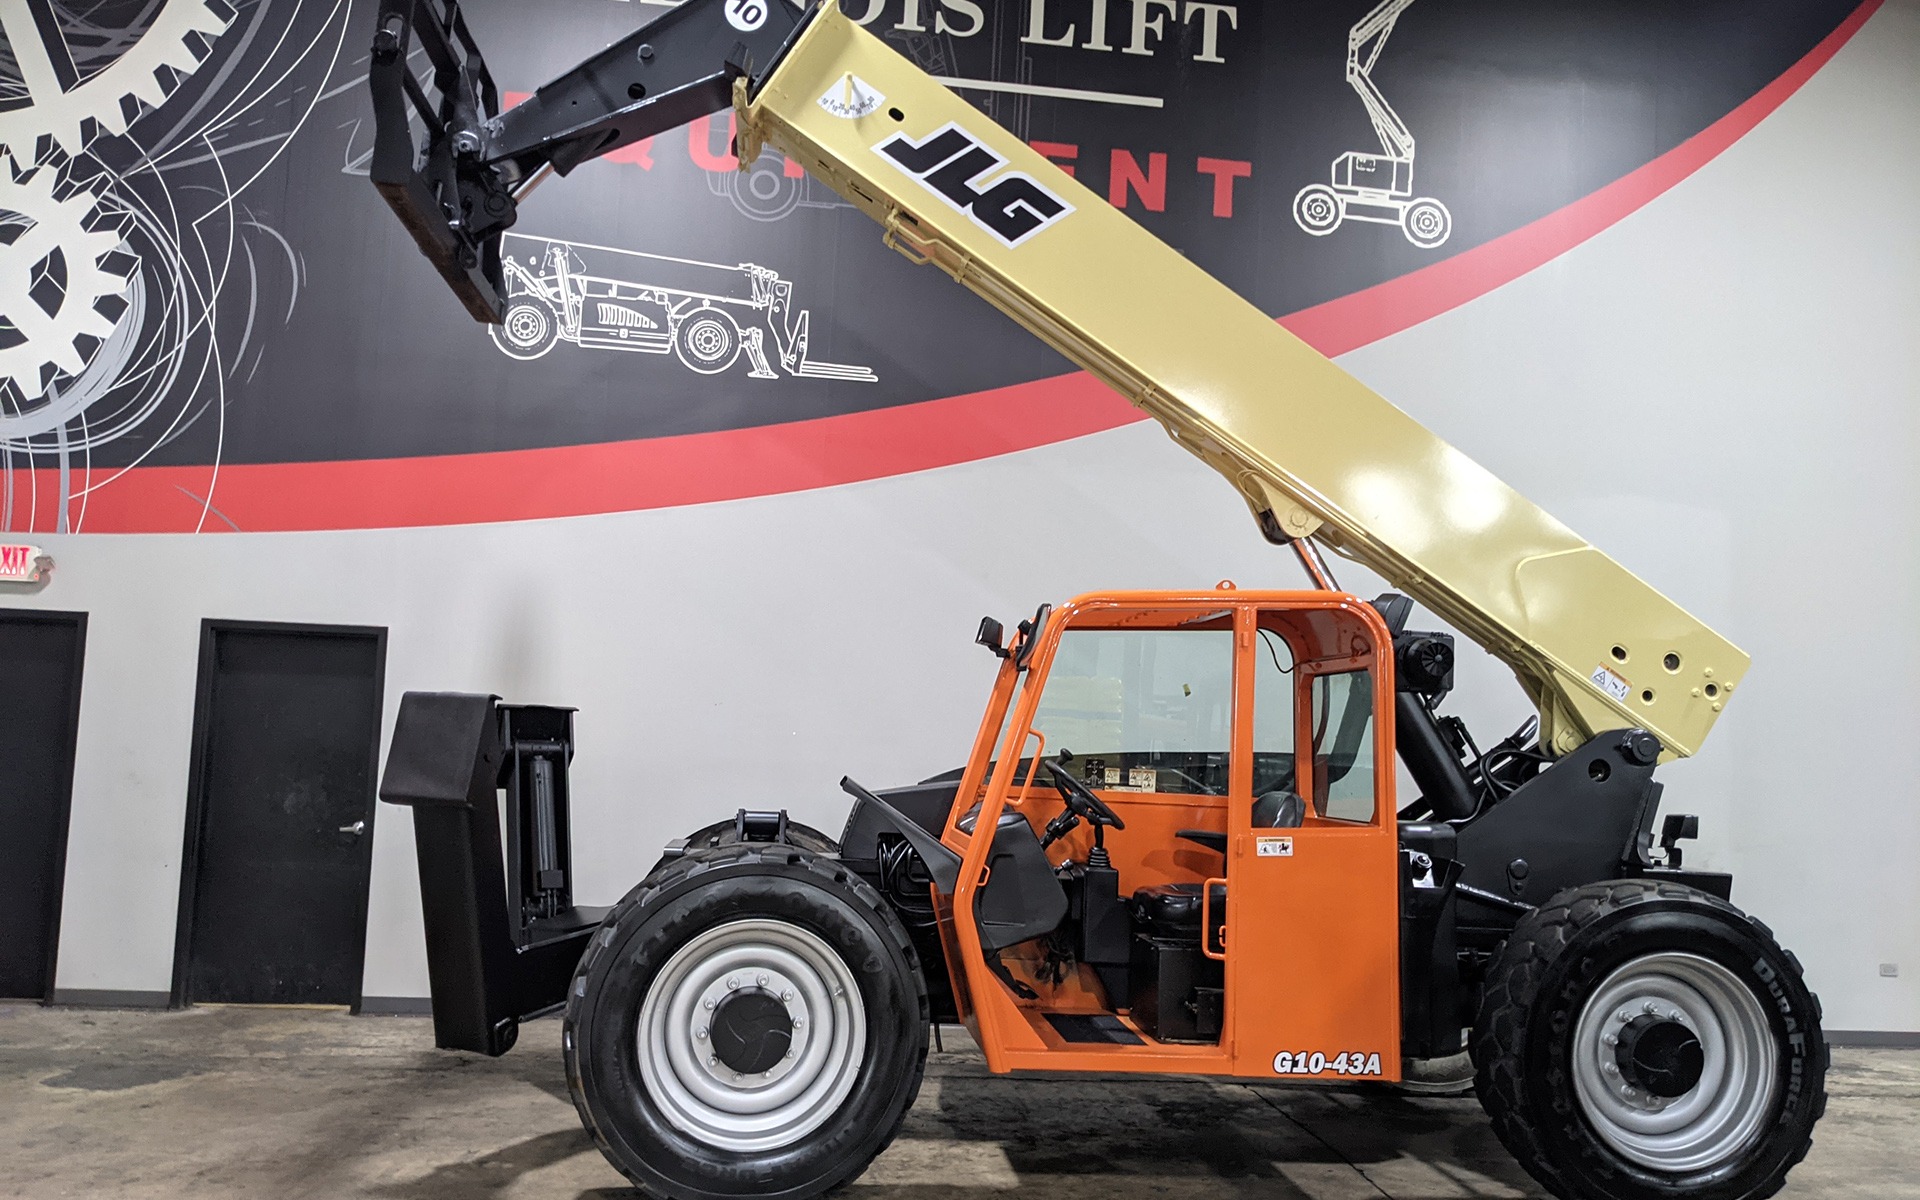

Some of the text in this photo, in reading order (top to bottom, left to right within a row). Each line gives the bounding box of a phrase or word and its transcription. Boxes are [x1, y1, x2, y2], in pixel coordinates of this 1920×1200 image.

[732, 0, 763, 25] 10
[1020, 0, 1238, 64] LIFT
[876, 125, 1070, 246] JLG
[0, 546, 30, 575] XIT
[1272, 1051, 1382, 1076] G10-43A
